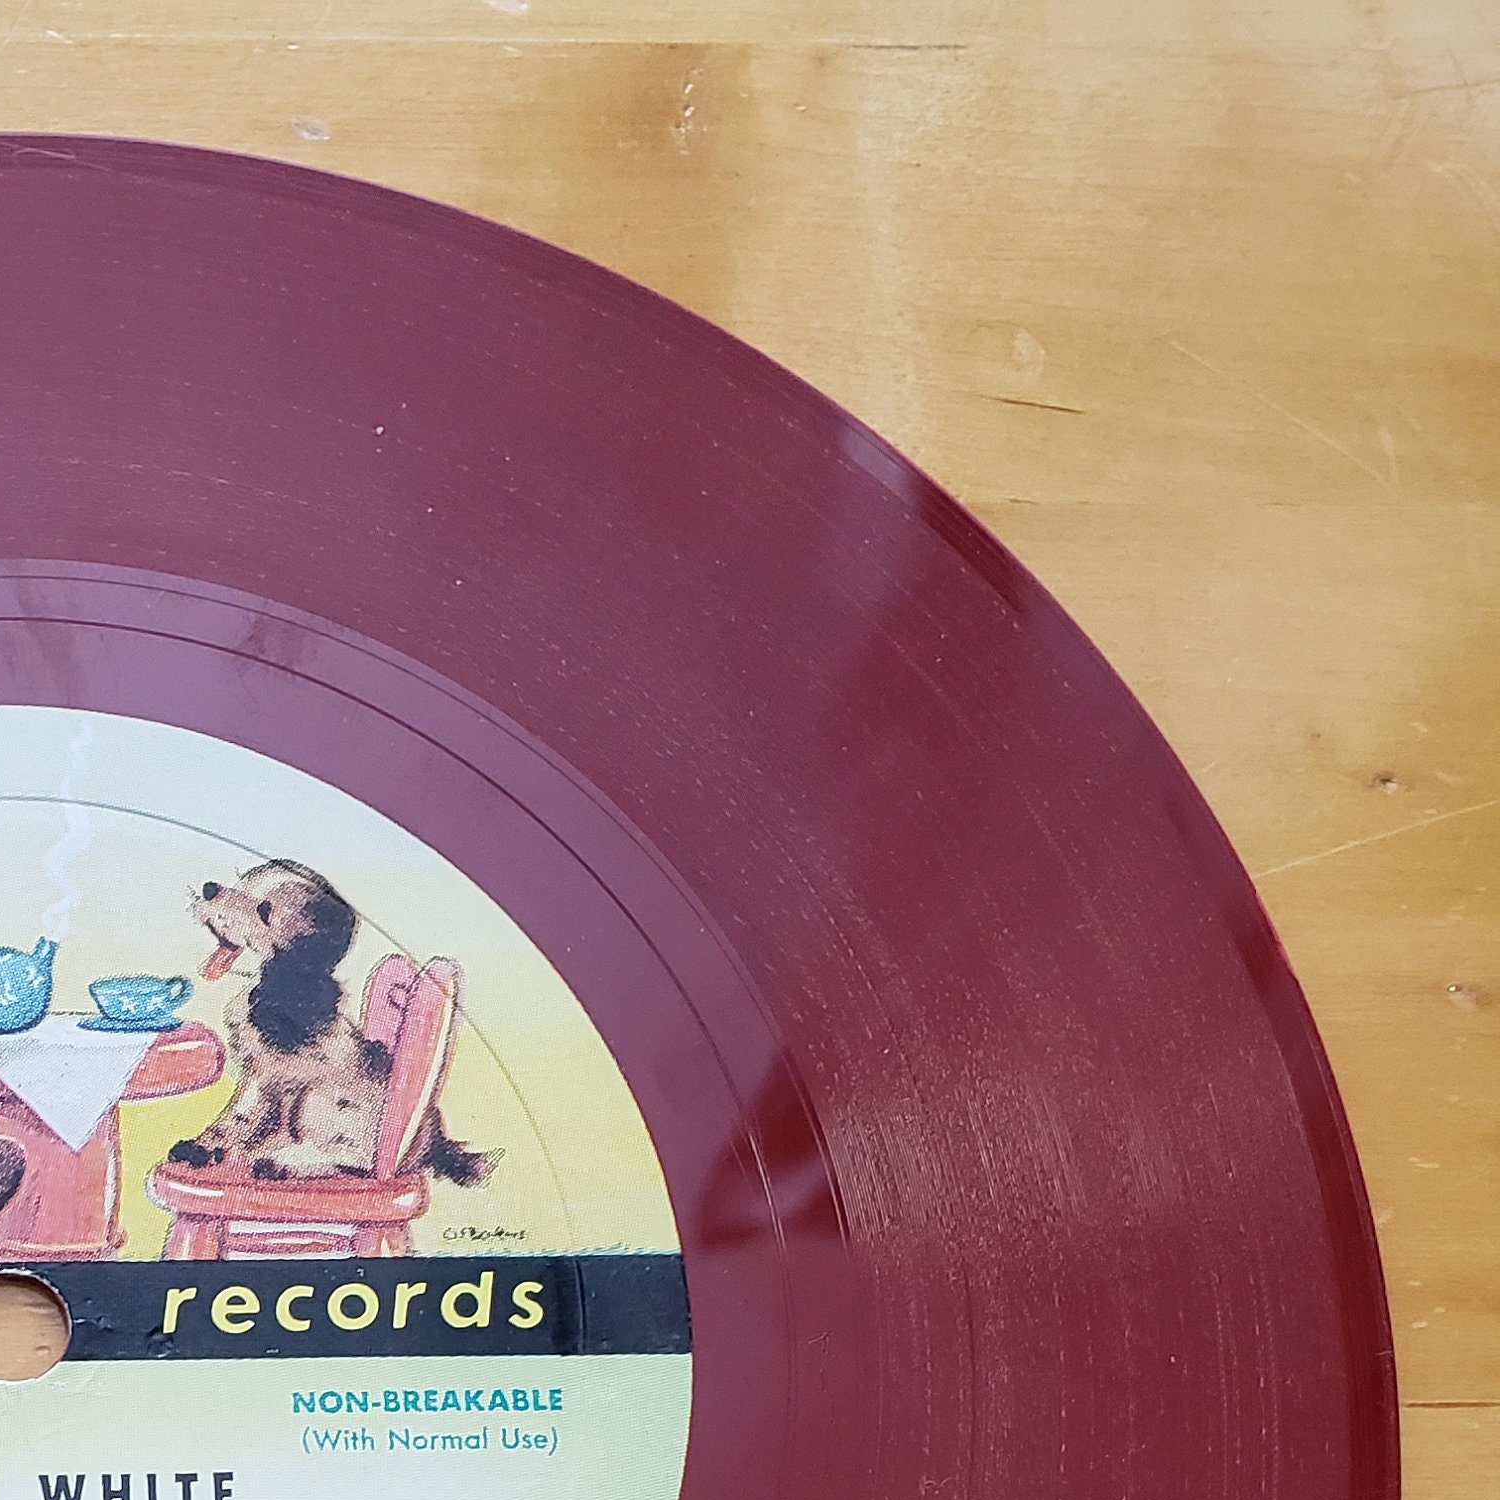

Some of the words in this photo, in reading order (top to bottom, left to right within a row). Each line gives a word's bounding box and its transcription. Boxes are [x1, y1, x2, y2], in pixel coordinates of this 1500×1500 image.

[162, 1271, 545, 1333] records
[291, 1388, 564, 1413] NON-BREAKABLE
[301, 1425, 376, 1454] (With
[388, 1426, 488, 1452] Normal
[501, 1426, 560, 1454] Use)
